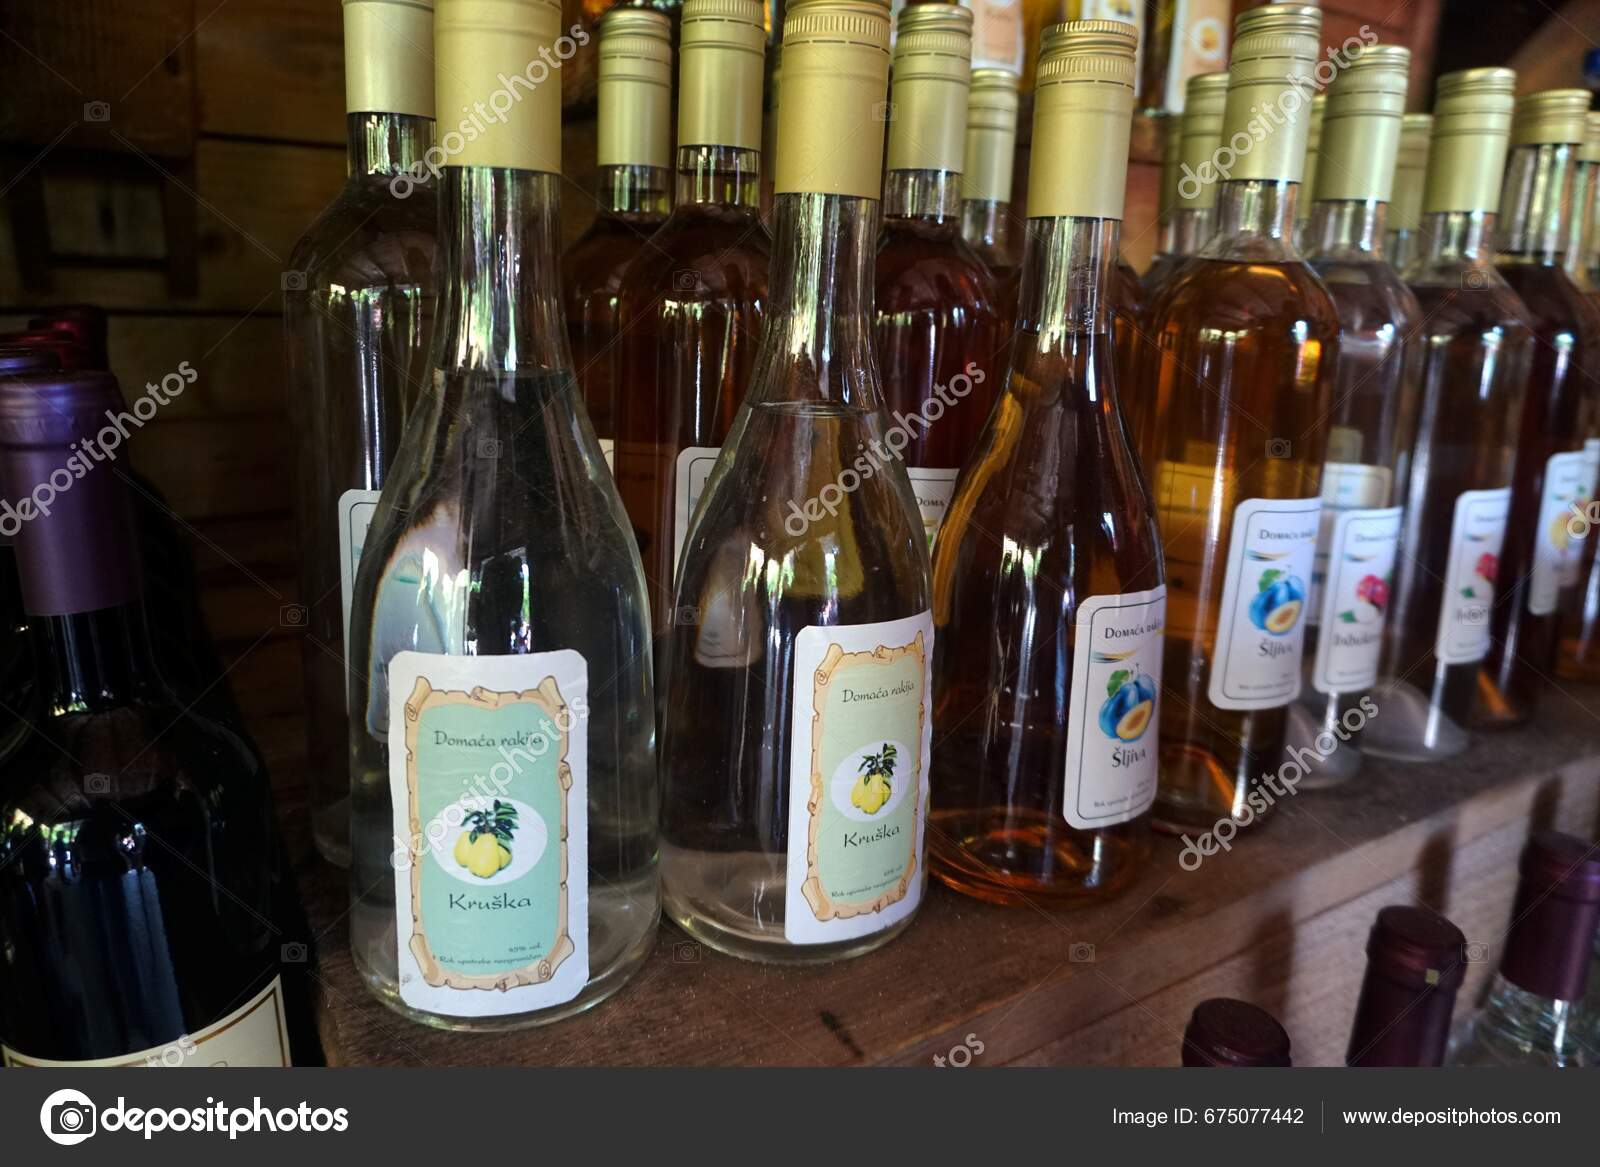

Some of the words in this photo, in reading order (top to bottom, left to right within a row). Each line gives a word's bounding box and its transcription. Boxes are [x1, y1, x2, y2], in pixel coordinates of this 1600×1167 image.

[842, 687, 889, 702] Domaća
[434, 730, 496, 747] Domaća
[844, 824, 900, 848] Kruška
[449, 892, 532, 910] Kruška
